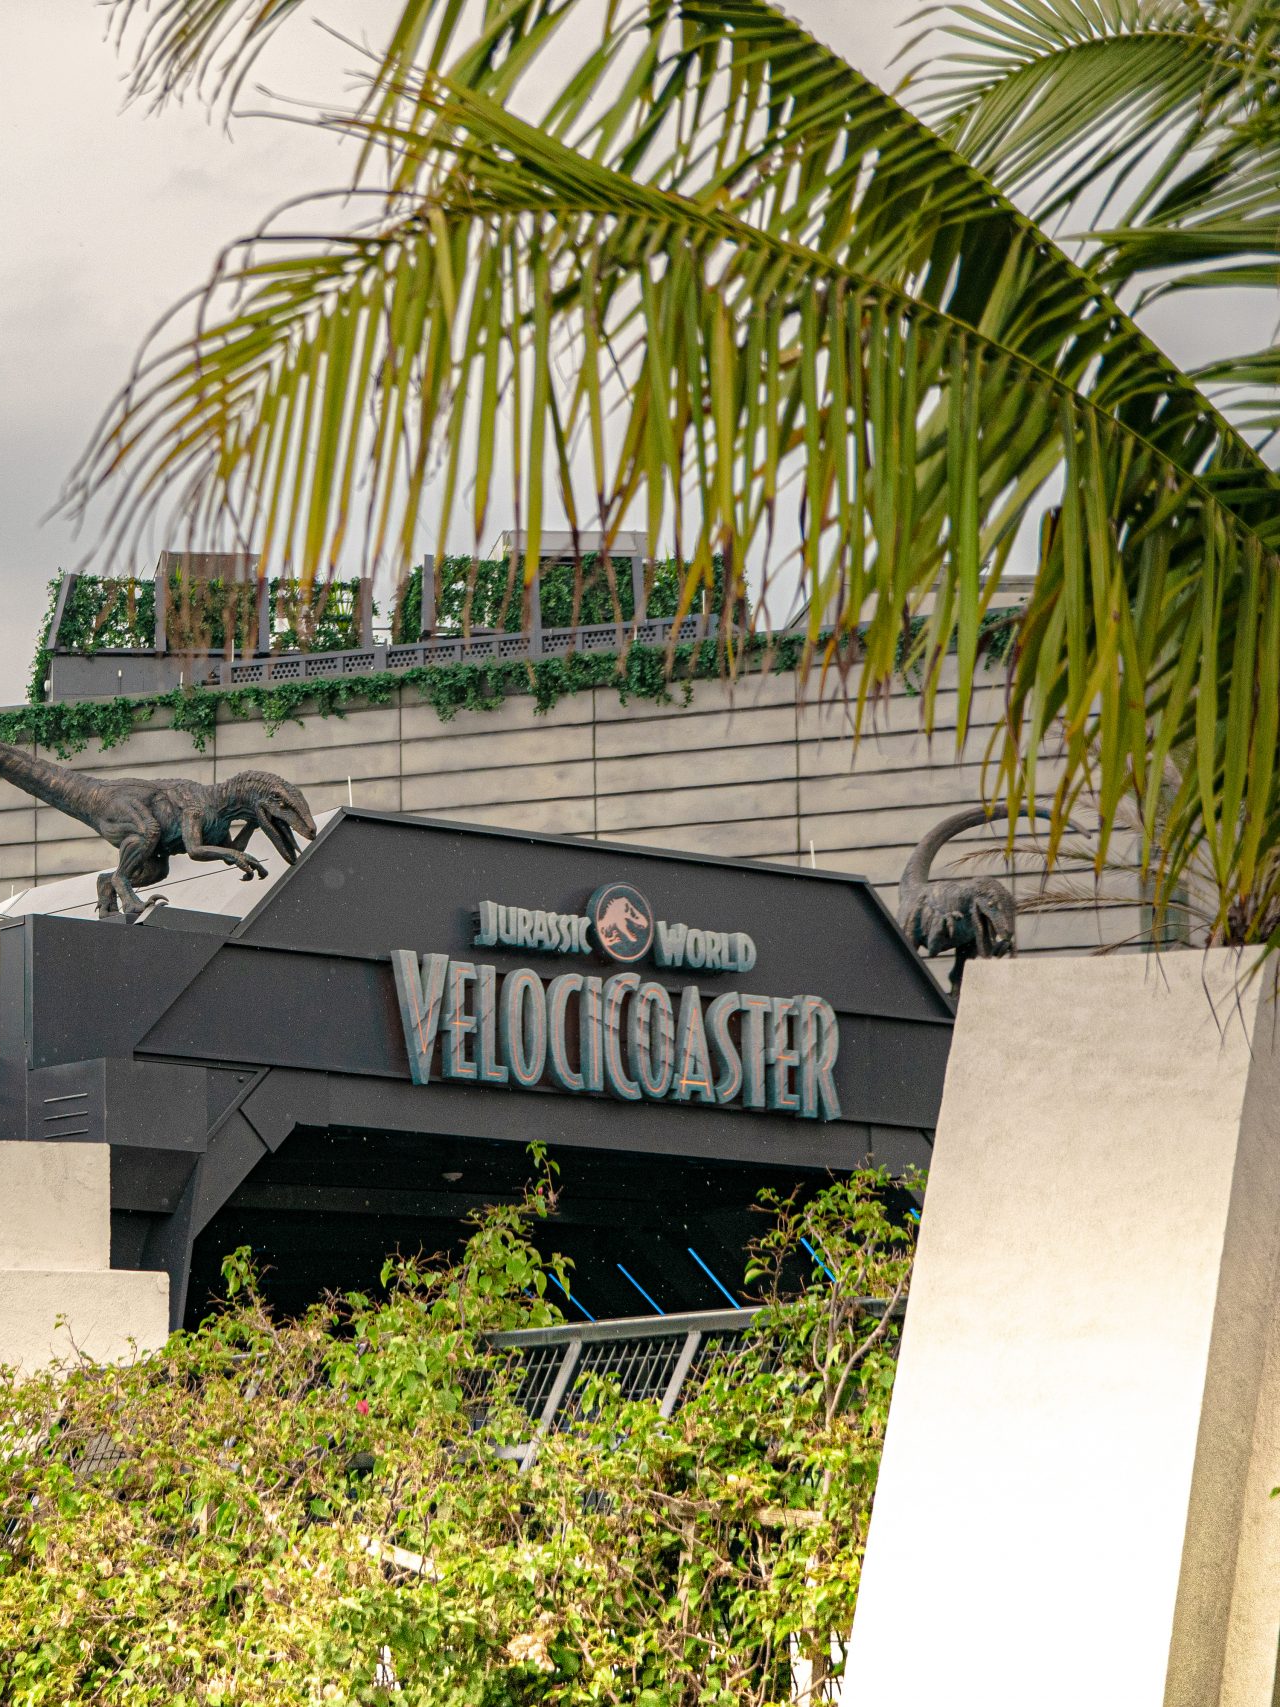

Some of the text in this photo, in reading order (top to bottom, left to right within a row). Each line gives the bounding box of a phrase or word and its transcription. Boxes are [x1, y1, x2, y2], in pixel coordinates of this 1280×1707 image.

[473, 900, 757, 973] JURASSIC WORLD
[391, 949, 842, 1121] VELOCICOASTER
